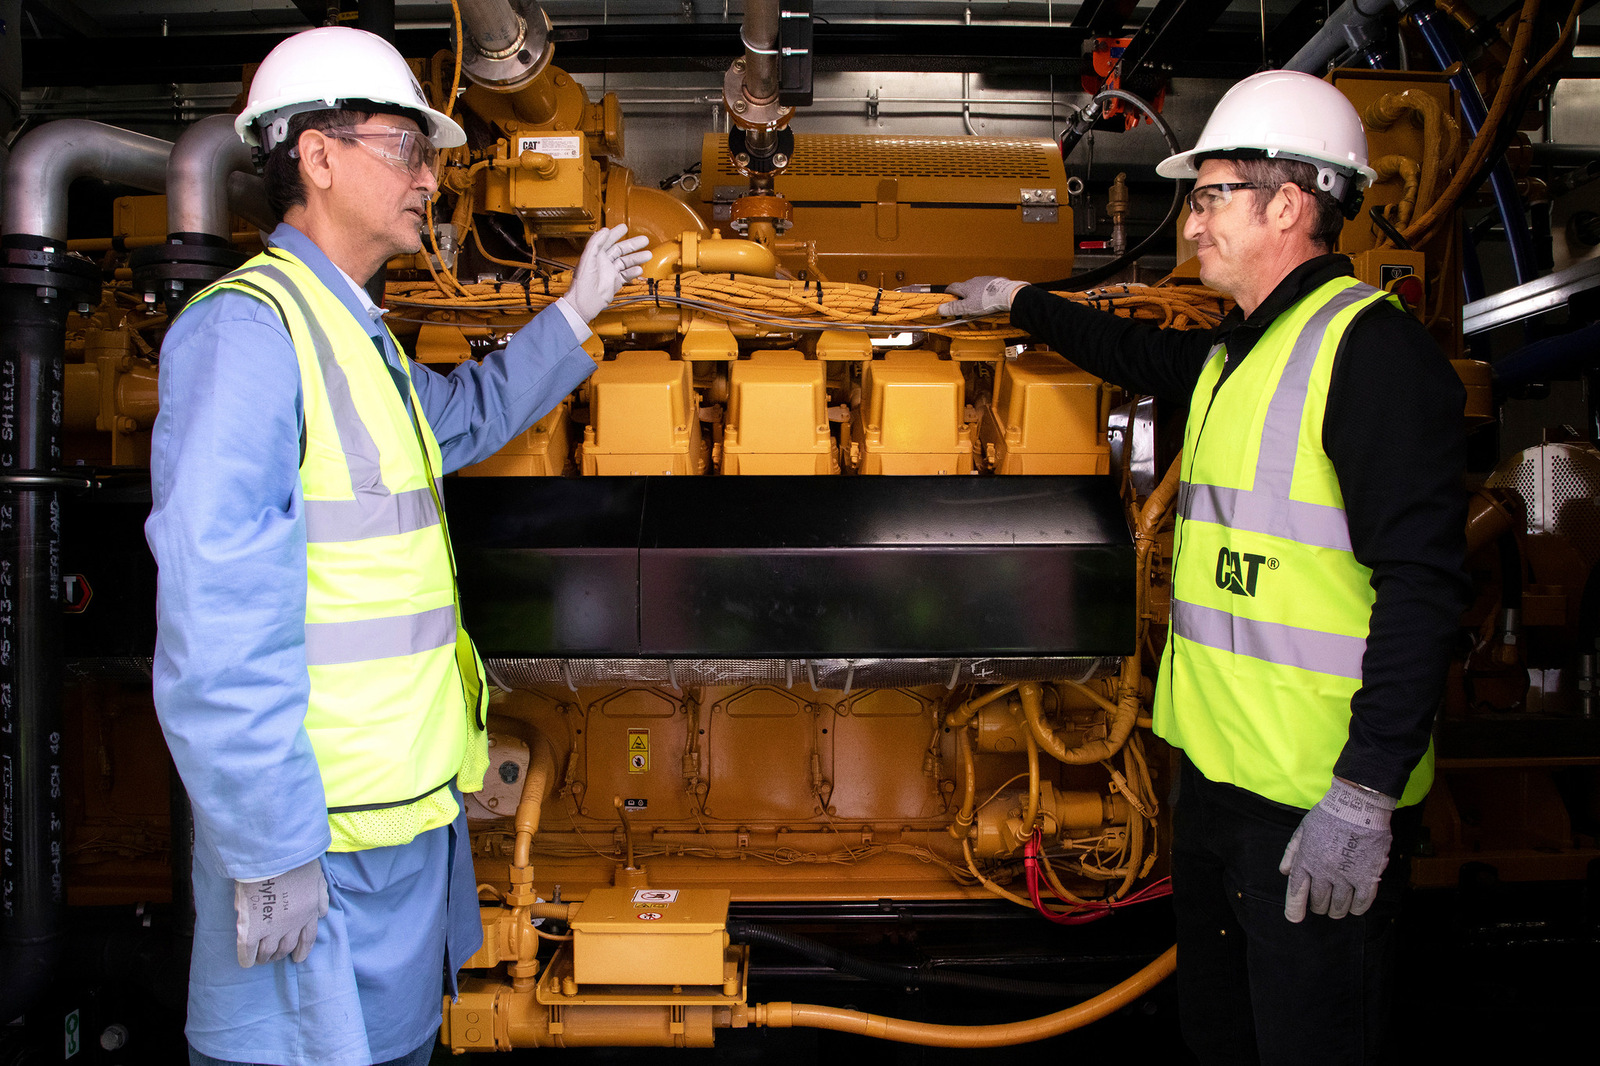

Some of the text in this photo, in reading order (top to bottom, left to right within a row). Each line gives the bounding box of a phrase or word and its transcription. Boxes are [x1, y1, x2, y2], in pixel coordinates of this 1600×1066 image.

[49, 731, 61, 755] 40
[1338, 832, 1360, 872] HyFlex
[258, 878, 277, 921] HyFlex
